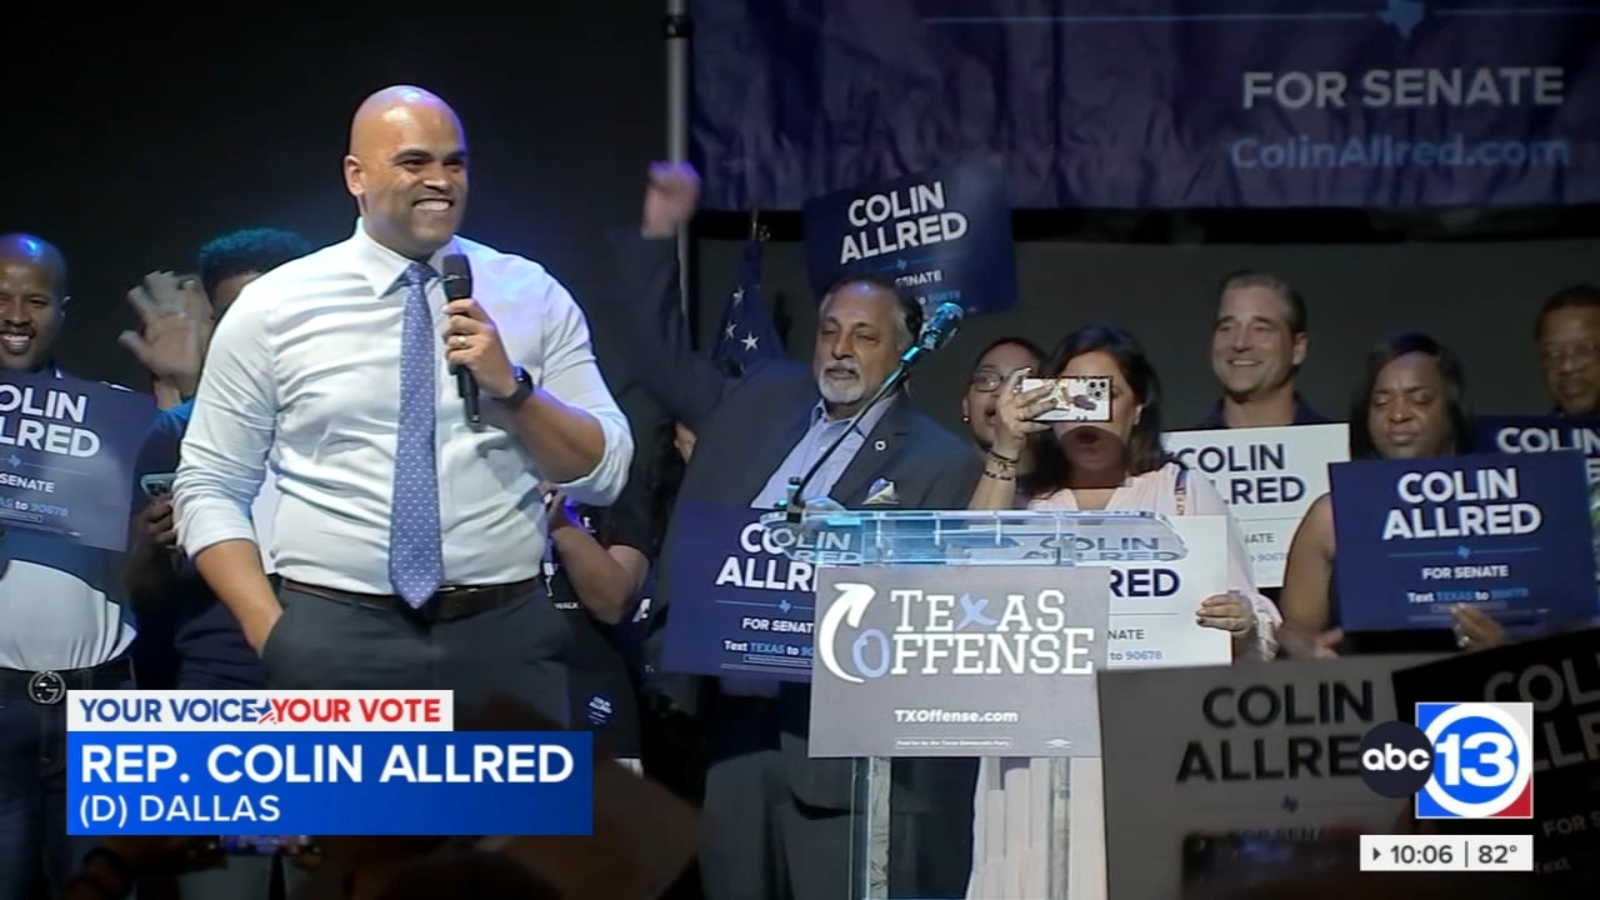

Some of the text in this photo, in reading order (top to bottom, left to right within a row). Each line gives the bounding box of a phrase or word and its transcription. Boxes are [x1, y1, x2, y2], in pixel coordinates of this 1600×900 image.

[1243, 67, 1565, 109] FOR SENATE
[1230, 133, 1573, 170] ColinAllred.com
[848, 181, 945, 227] COLIN
[840, 211, 968, 265] ALLRED
[0, 472, 55, 494] SENATE
[1397, 468, 1518, 504] COLIN
[1382, 503, 1542, 540] ALLRED
[715, 557, 817, 593] ALLR
[1422, 565, 1509, 581] FOR SENATE
[1407, 591, 1435, 603] Text
[1475, 590, 1490, 601] to
[743, 618, 769, 631] FOR
[724, 640, 748, 652] Text
[750, 641, 785, 655] TEXAS
[786, 645, 799, 656] to
[853, 628, 1095, 678] OFFENSE
[1110, 650, 1163, 661] to 90678
[894, 709, 1018, 723] TXOffense.com
[1202, 680, 1374, 729] COLIN
